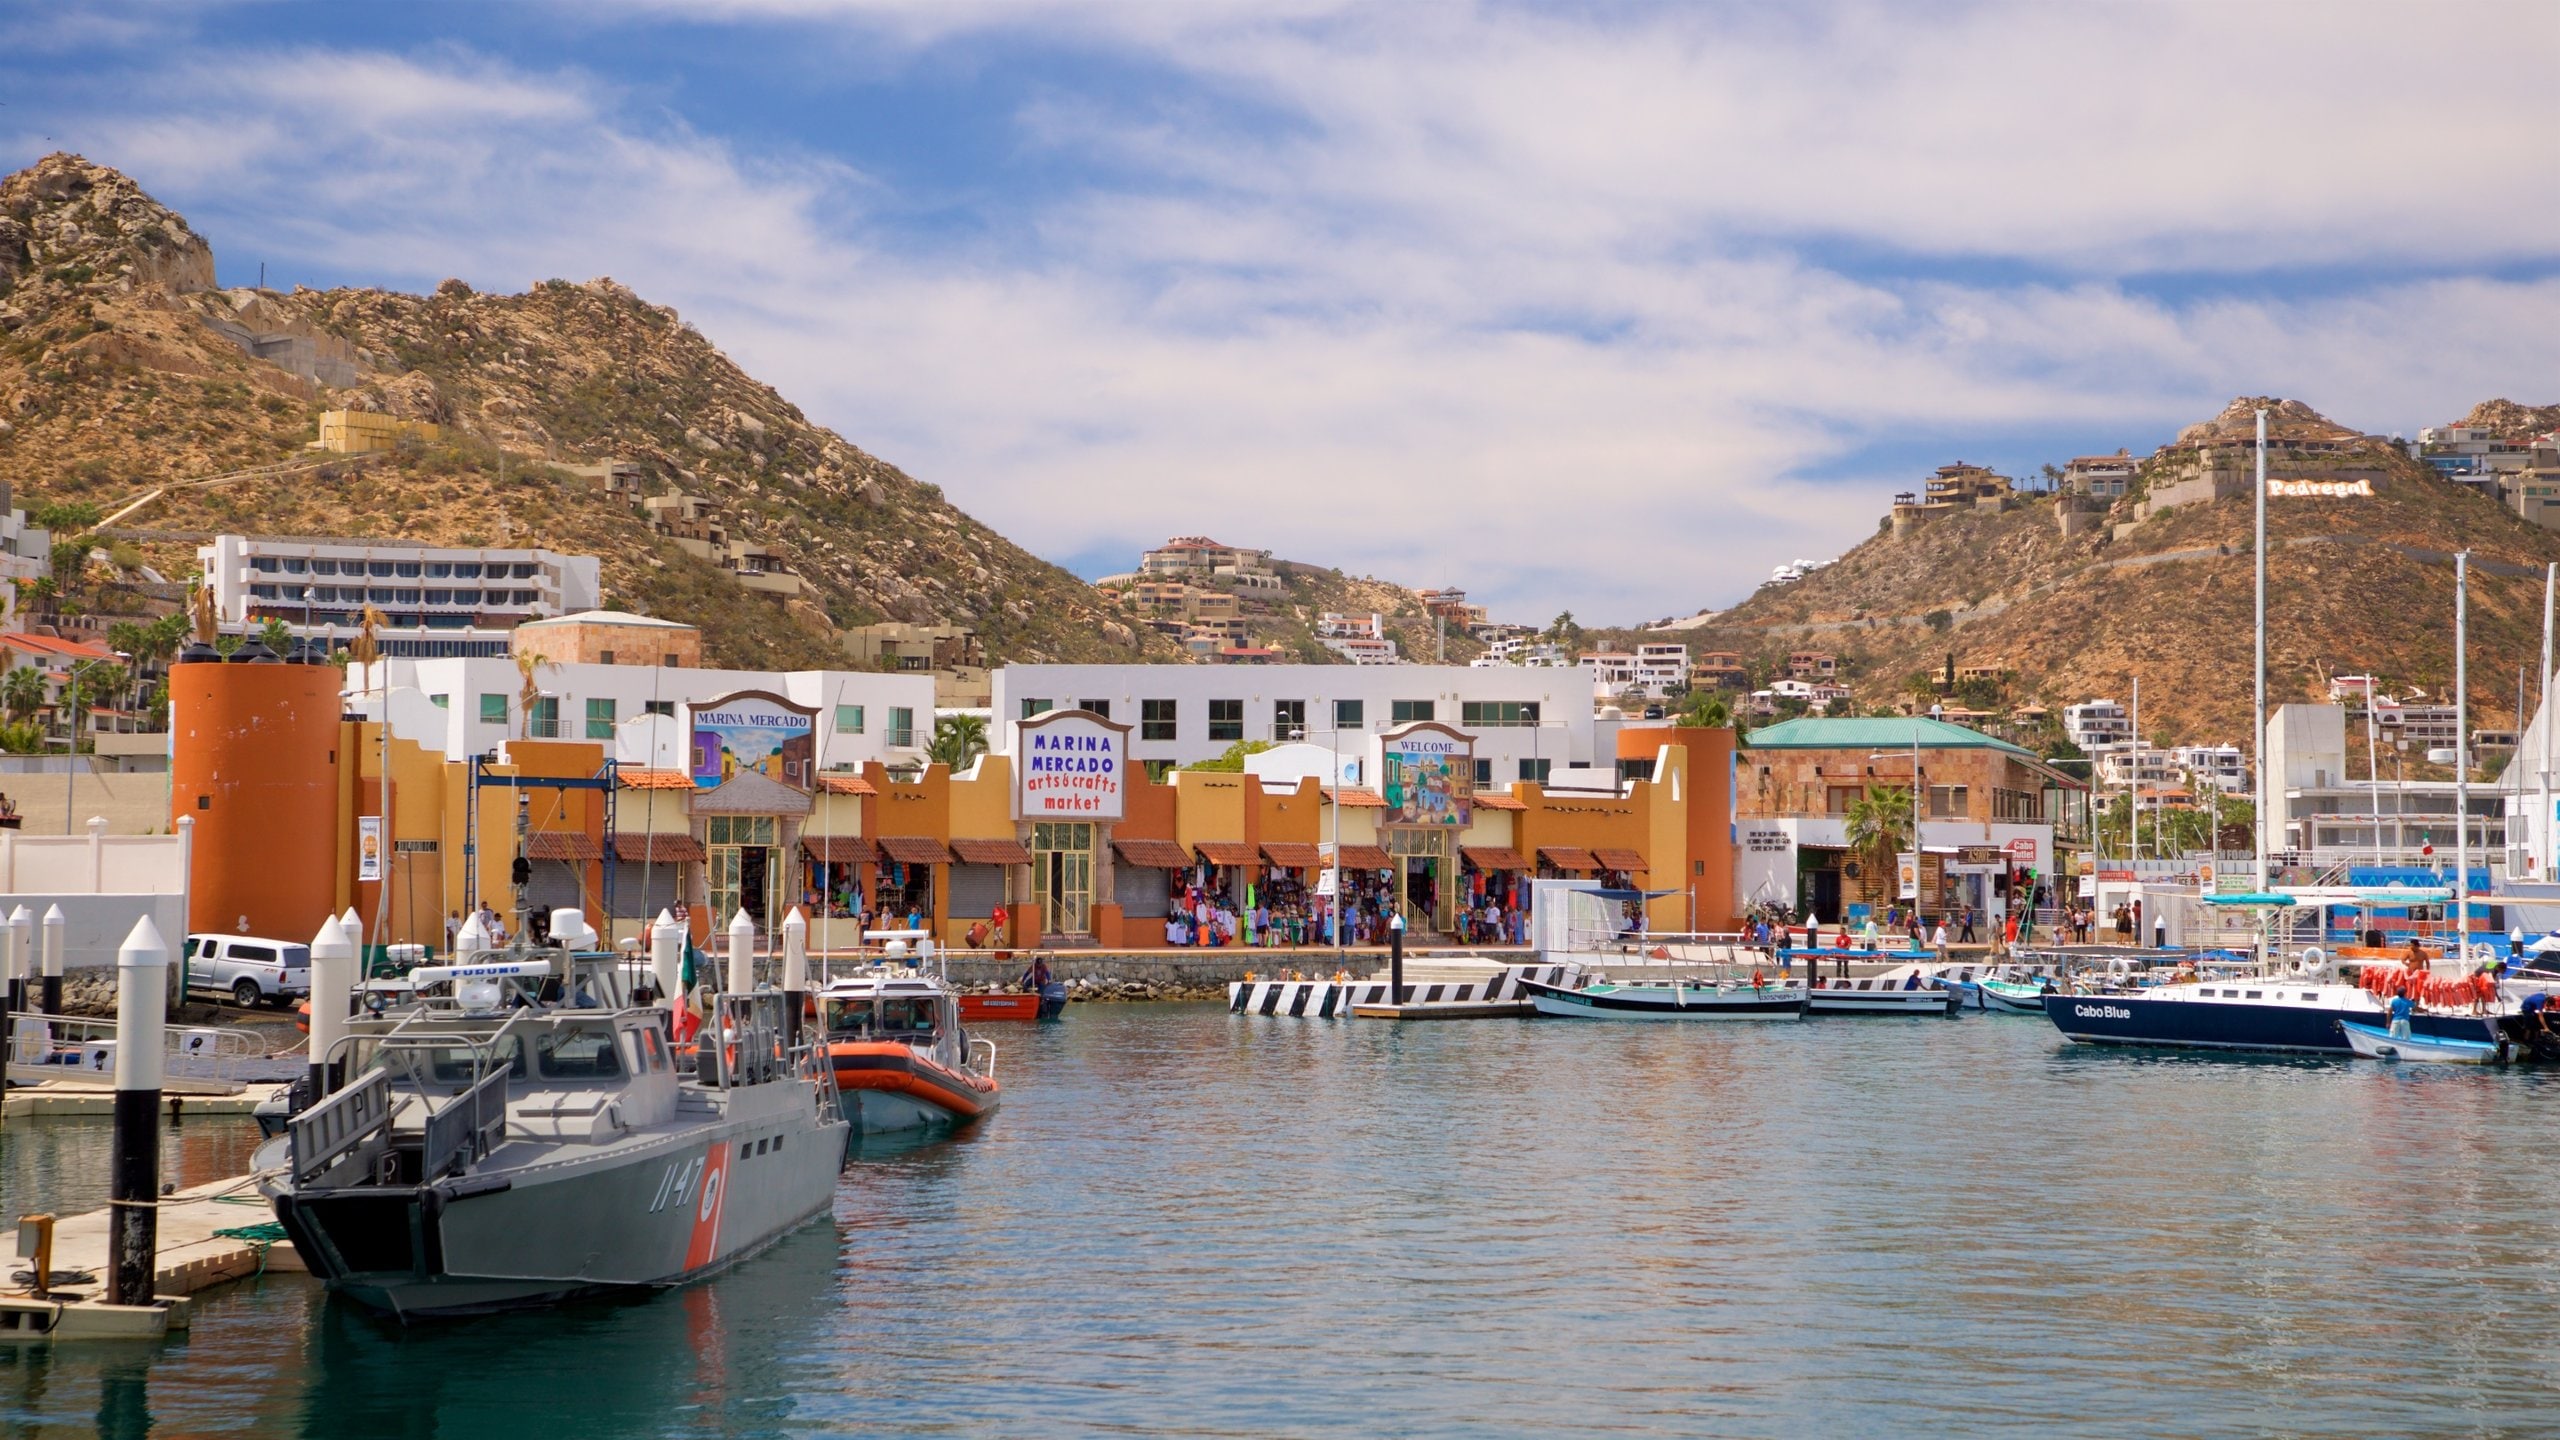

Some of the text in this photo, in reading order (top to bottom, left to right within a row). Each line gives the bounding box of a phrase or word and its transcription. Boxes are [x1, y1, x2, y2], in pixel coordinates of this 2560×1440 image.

[698, 713, 807, 727] MARINA MERCADO
[1034, 735, 1111, 752] MARINA
[1400, 741, 1454, 753] WELCOME
[1031, 756, 1114, 773] MERCADO
[1072, 774, 1117, 793] crafts
[1044, 793, 1101, 811] market
[2013, 841, 2034, 850] Cabo
[451, 966, 520, 977] FURUNO
[2075, 1004, 2131, 1019] Cabo Blue
[649, 1155, 706, 1213] 1147
